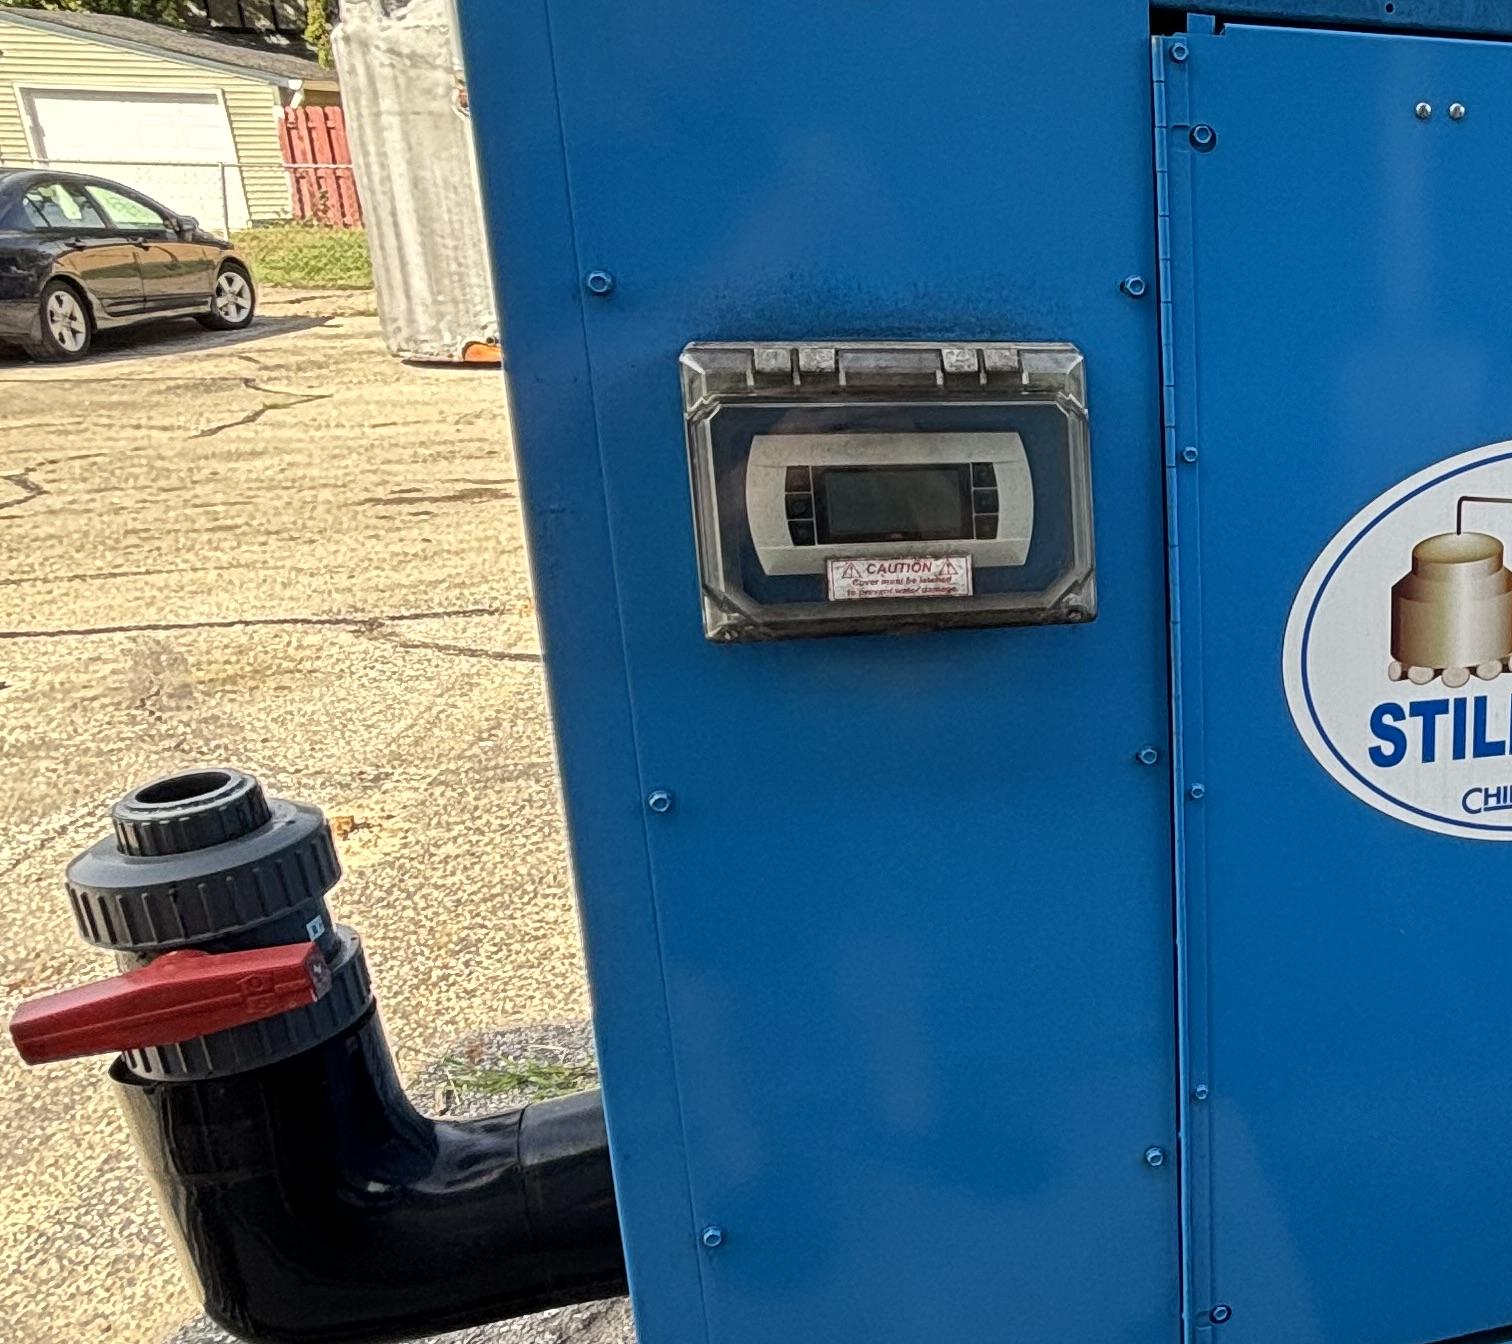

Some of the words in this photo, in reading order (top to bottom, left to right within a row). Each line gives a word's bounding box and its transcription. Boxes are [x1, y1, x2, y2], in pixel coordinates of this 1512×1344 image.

[866, 562, 932, 574] CAUTION
[852, 578, 879, 586] Cover
[881, 577, 903, 585] must
[859, 588, 892, 596] prevent
[895, 586, 920, 595] water
